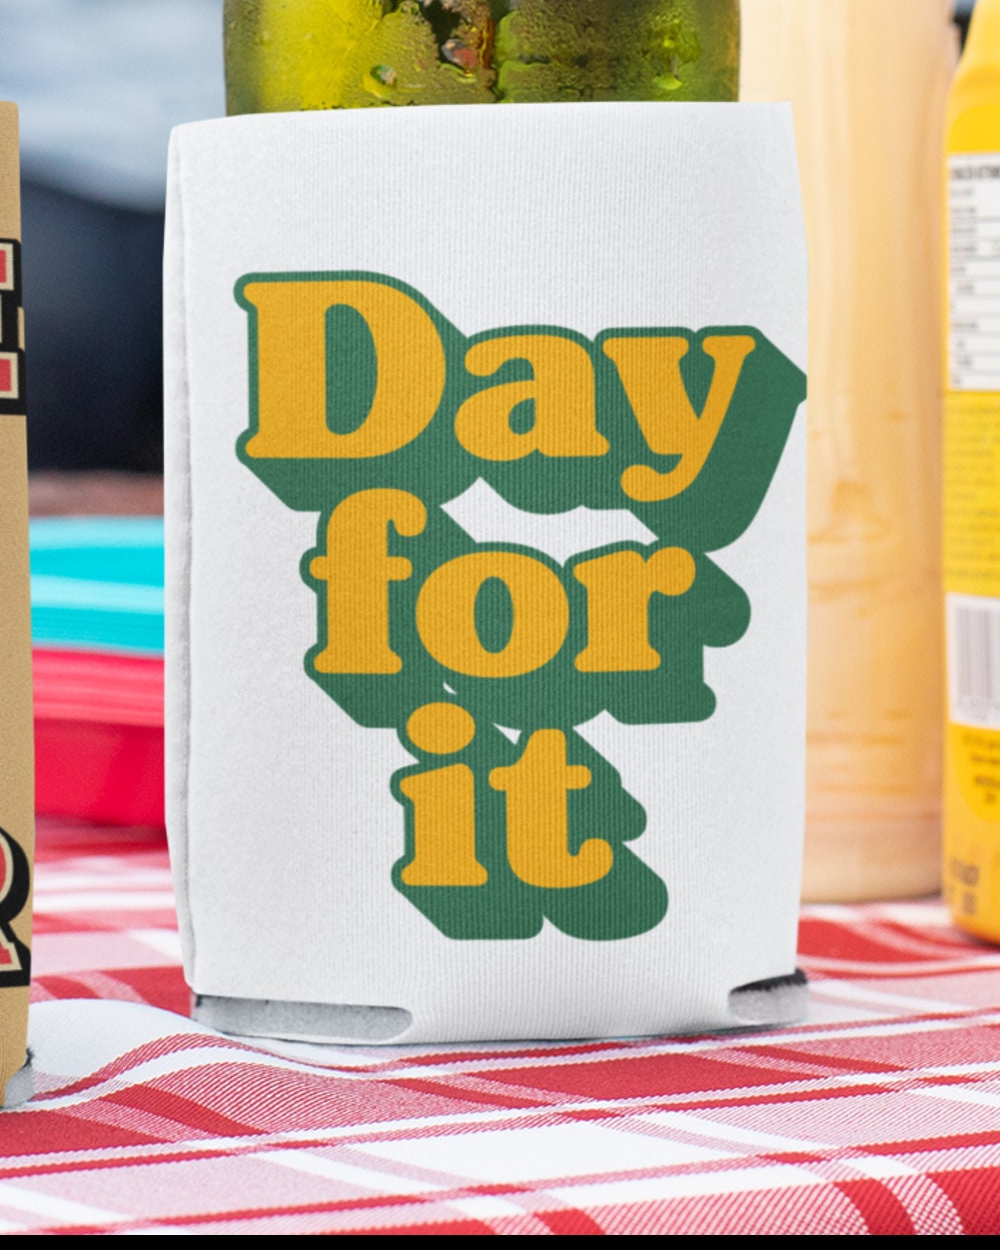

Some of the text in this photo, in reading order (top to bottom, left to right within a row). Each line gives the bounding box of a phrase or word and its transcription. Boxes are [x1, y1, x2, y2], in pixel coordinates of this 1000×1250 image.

[236, 272, 764, 510] Day
[302, 484, 706, 686] for
[393, 699, 626, 898] it
